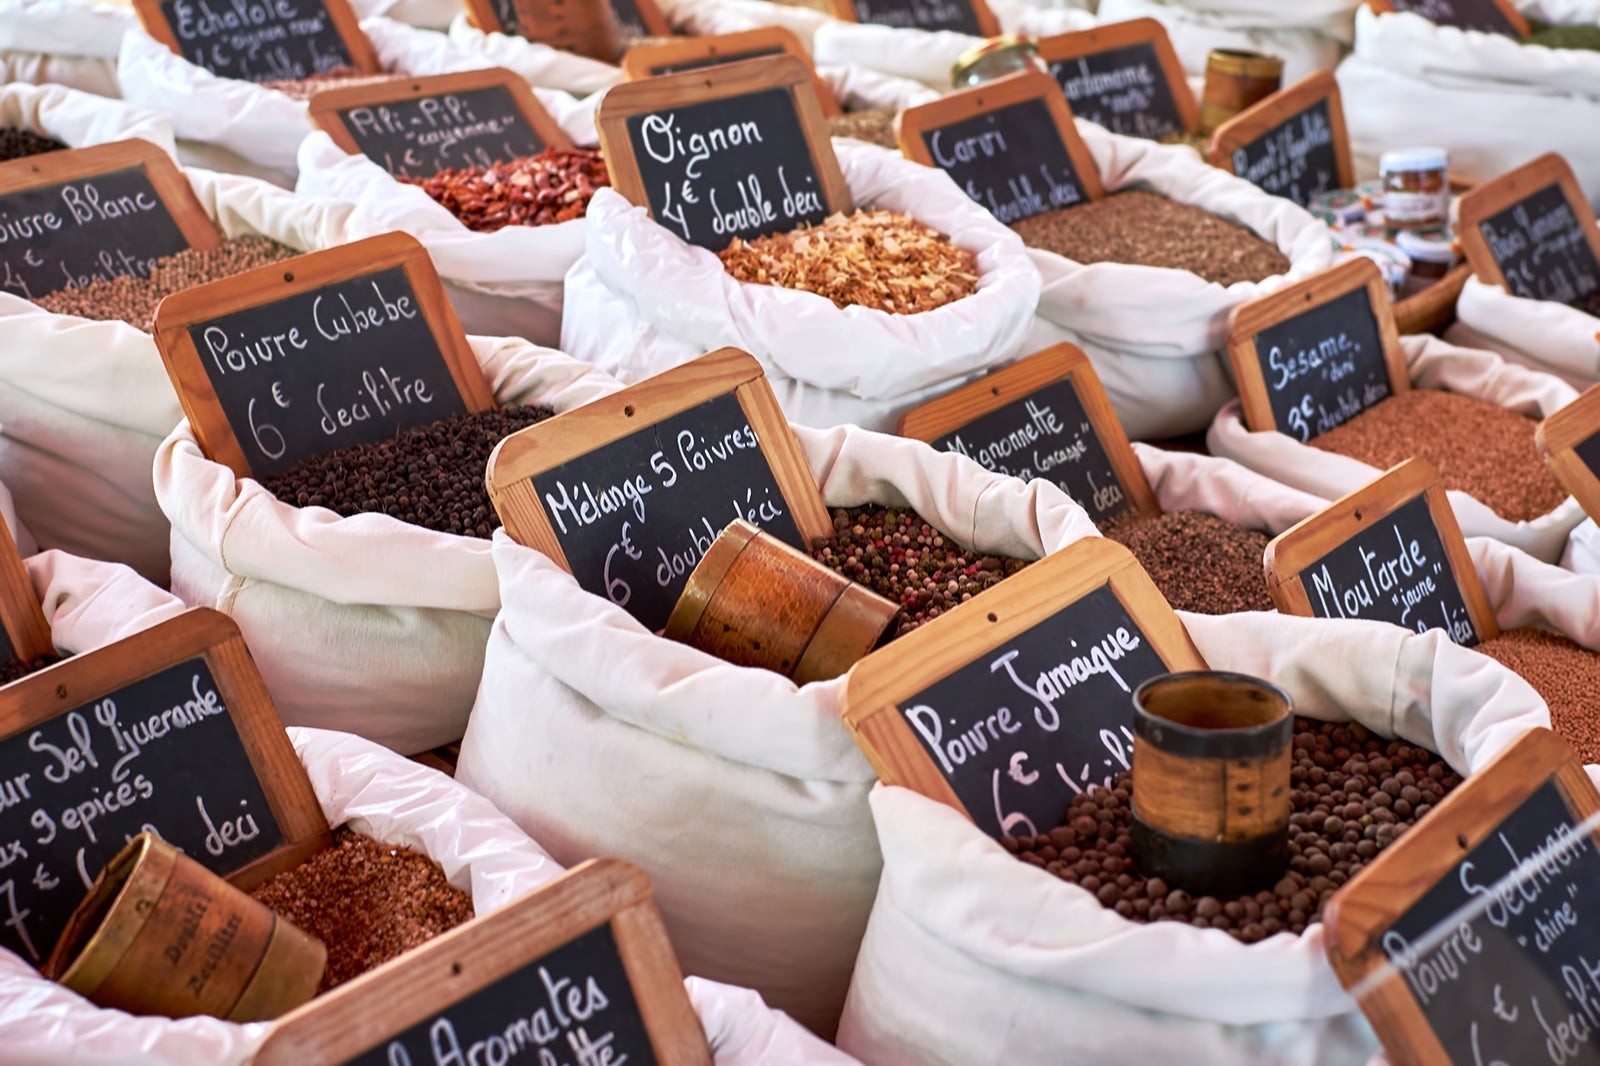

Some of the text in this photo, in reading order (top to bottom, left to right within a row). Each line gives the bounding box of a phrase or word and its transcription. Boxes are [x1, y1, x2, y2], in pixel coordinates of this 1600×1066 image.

[641, 113, 764, 179] Oignon
[61, 183, 157, 226] Blanc
[709, 173, 778, 235] double
[203, 280, 417, 375] Poivre Cubebe
[316, 366, 433, 436] decilitre
[545, 423, 760, 535] Mélange 5 Poivres
[1311, 523, 1427, 621] Moutarde
[28, 711, 99, 783] Sel
[904, 704, 1023, 774] Poivre
[30, 808, 57, 845] 9
[196, 795, 260, 857] deci
[430, 966, 609, 1066] Aromates
